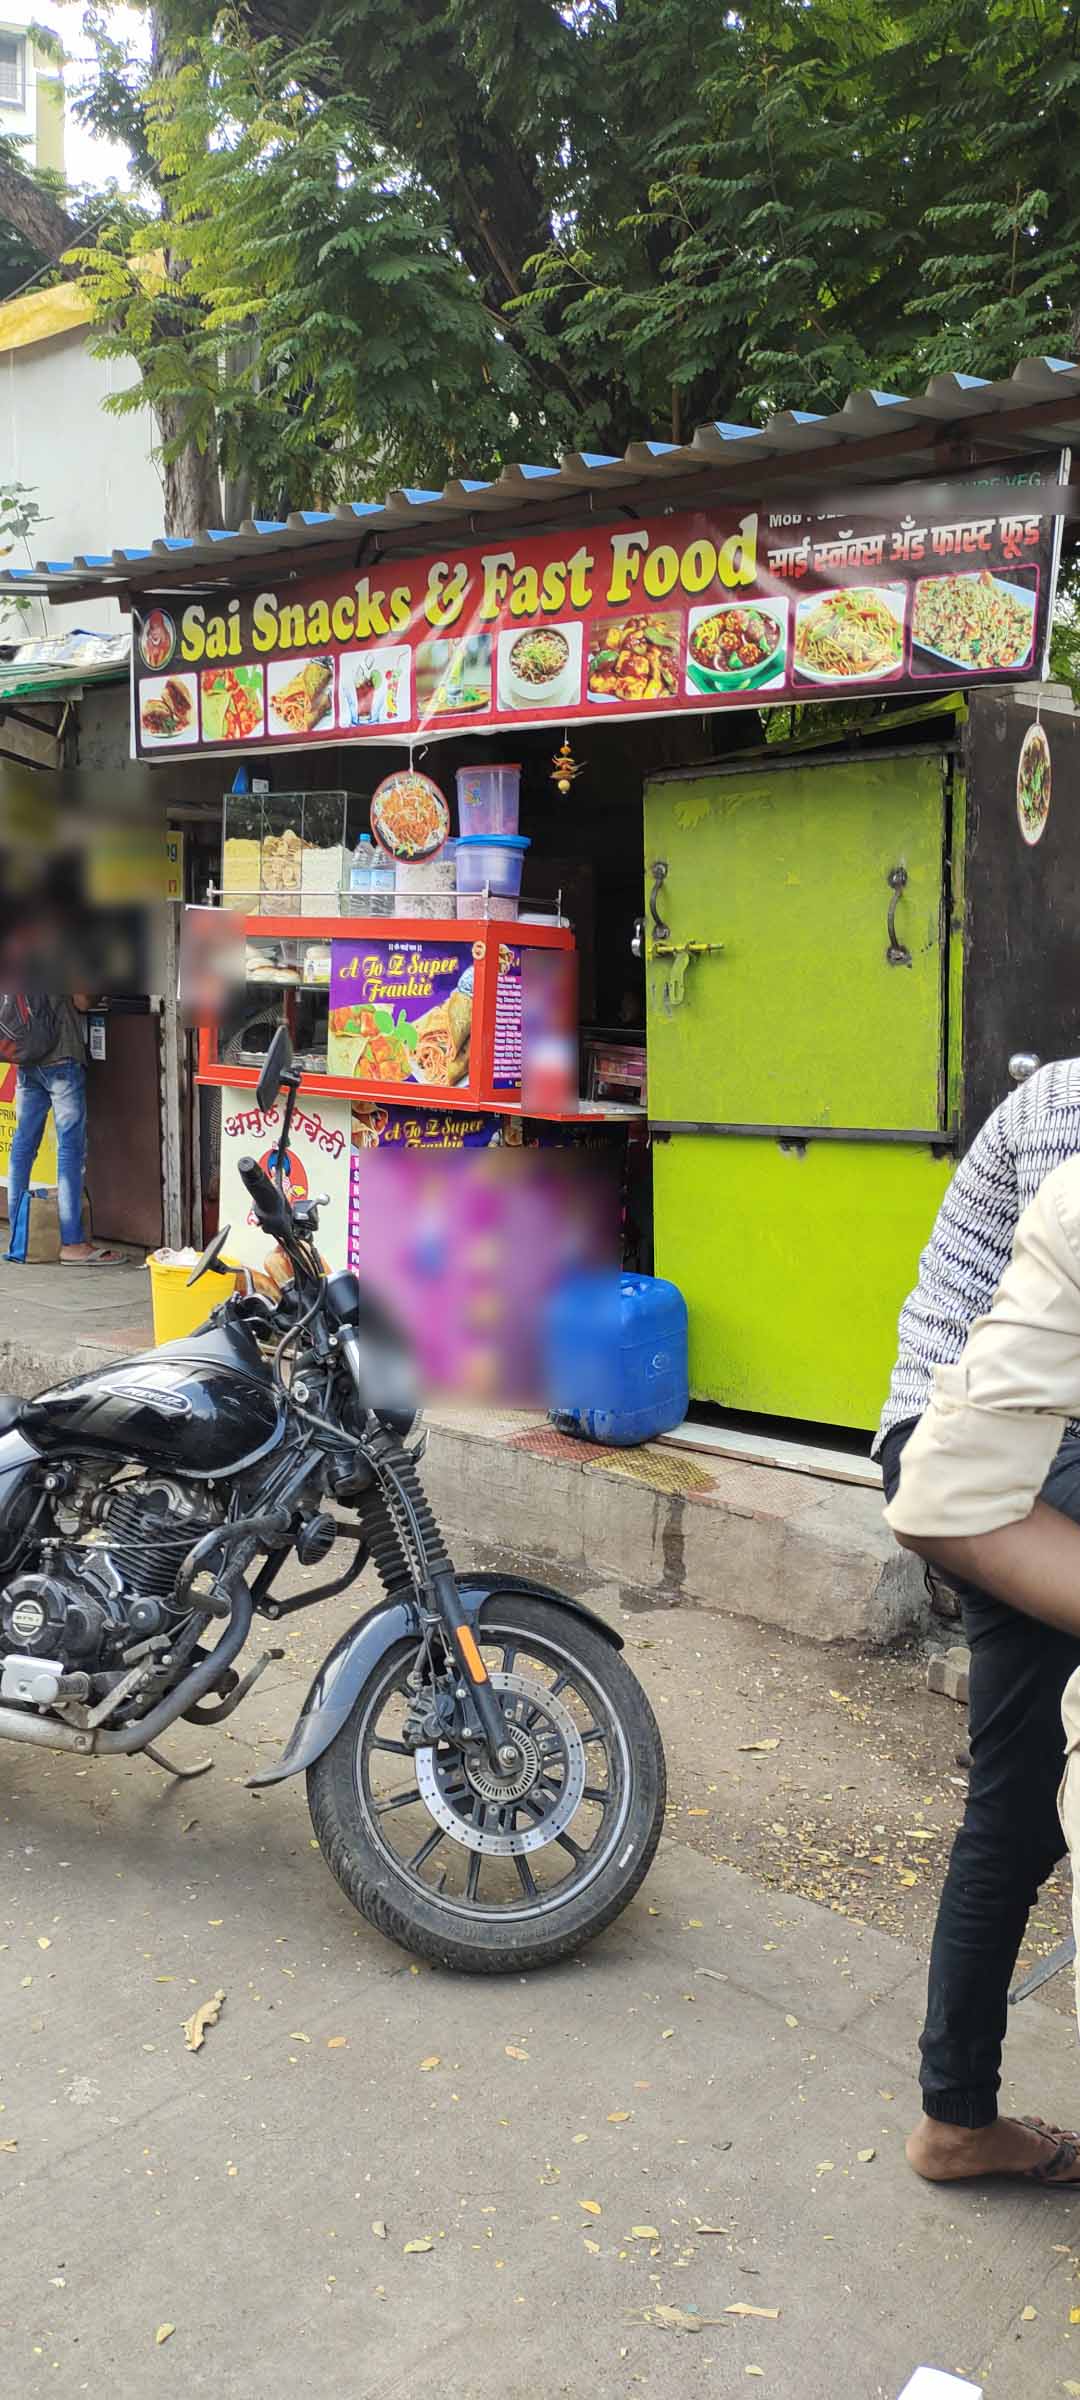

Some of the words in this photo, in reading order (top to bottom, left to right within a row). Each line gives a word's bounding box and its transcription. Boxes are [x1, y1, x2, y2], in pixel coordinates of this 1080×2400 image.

[767, 536, 810, 577] साई
[931, 519, 996, 554] फास्ट
[1000, 514, 1043, 560] फूड
[180, 599, 242, 662] Sai
[251, 576, 413, 652] Snacks
[424, 560, 469, 627] &
[479, 546, 595, 622] Fast
[606, 512, 759, 603] Food
[340, 956, 358, 978] A
[363, 955, 385, 977] To
[407, 952, 458, 979] Super
[363, 976, 434, 1002] Frankie
[384, 1122, 400, 1141] A
[441, 1116, 483, 1137] Super
